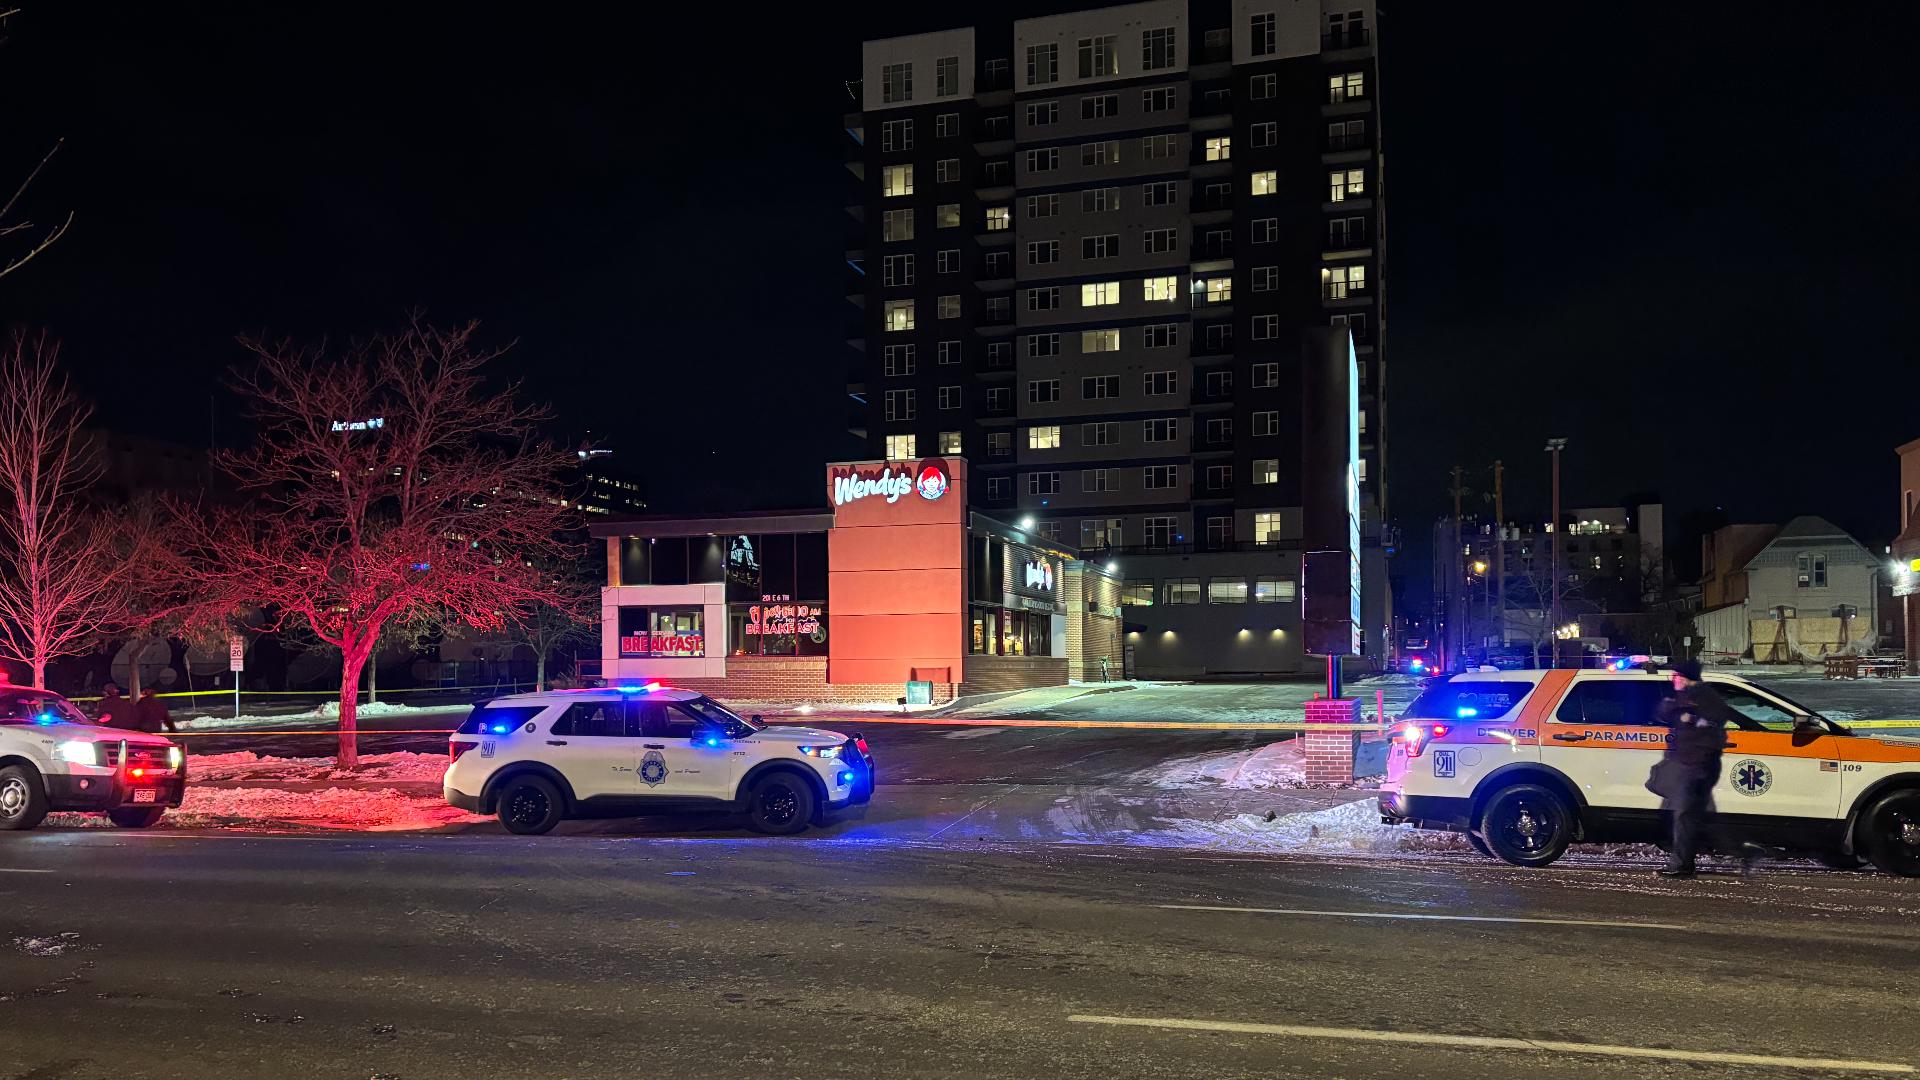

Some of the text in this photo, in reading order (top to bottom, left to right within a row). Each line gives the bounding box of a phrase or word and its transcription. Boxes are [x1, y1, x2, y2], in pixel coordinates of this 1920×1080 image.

[834, 468, 912, 506] Wendy's
[745, 622, 820, 635] BREAKFAST
[621, 635, 703, 653] BREAKFAST
[231, 649, 242, 657] 20
[483, 742, 495, 755] 911
[1437, 756, 1452, 772] 911
[1843, 764, 1862, 772] 109
